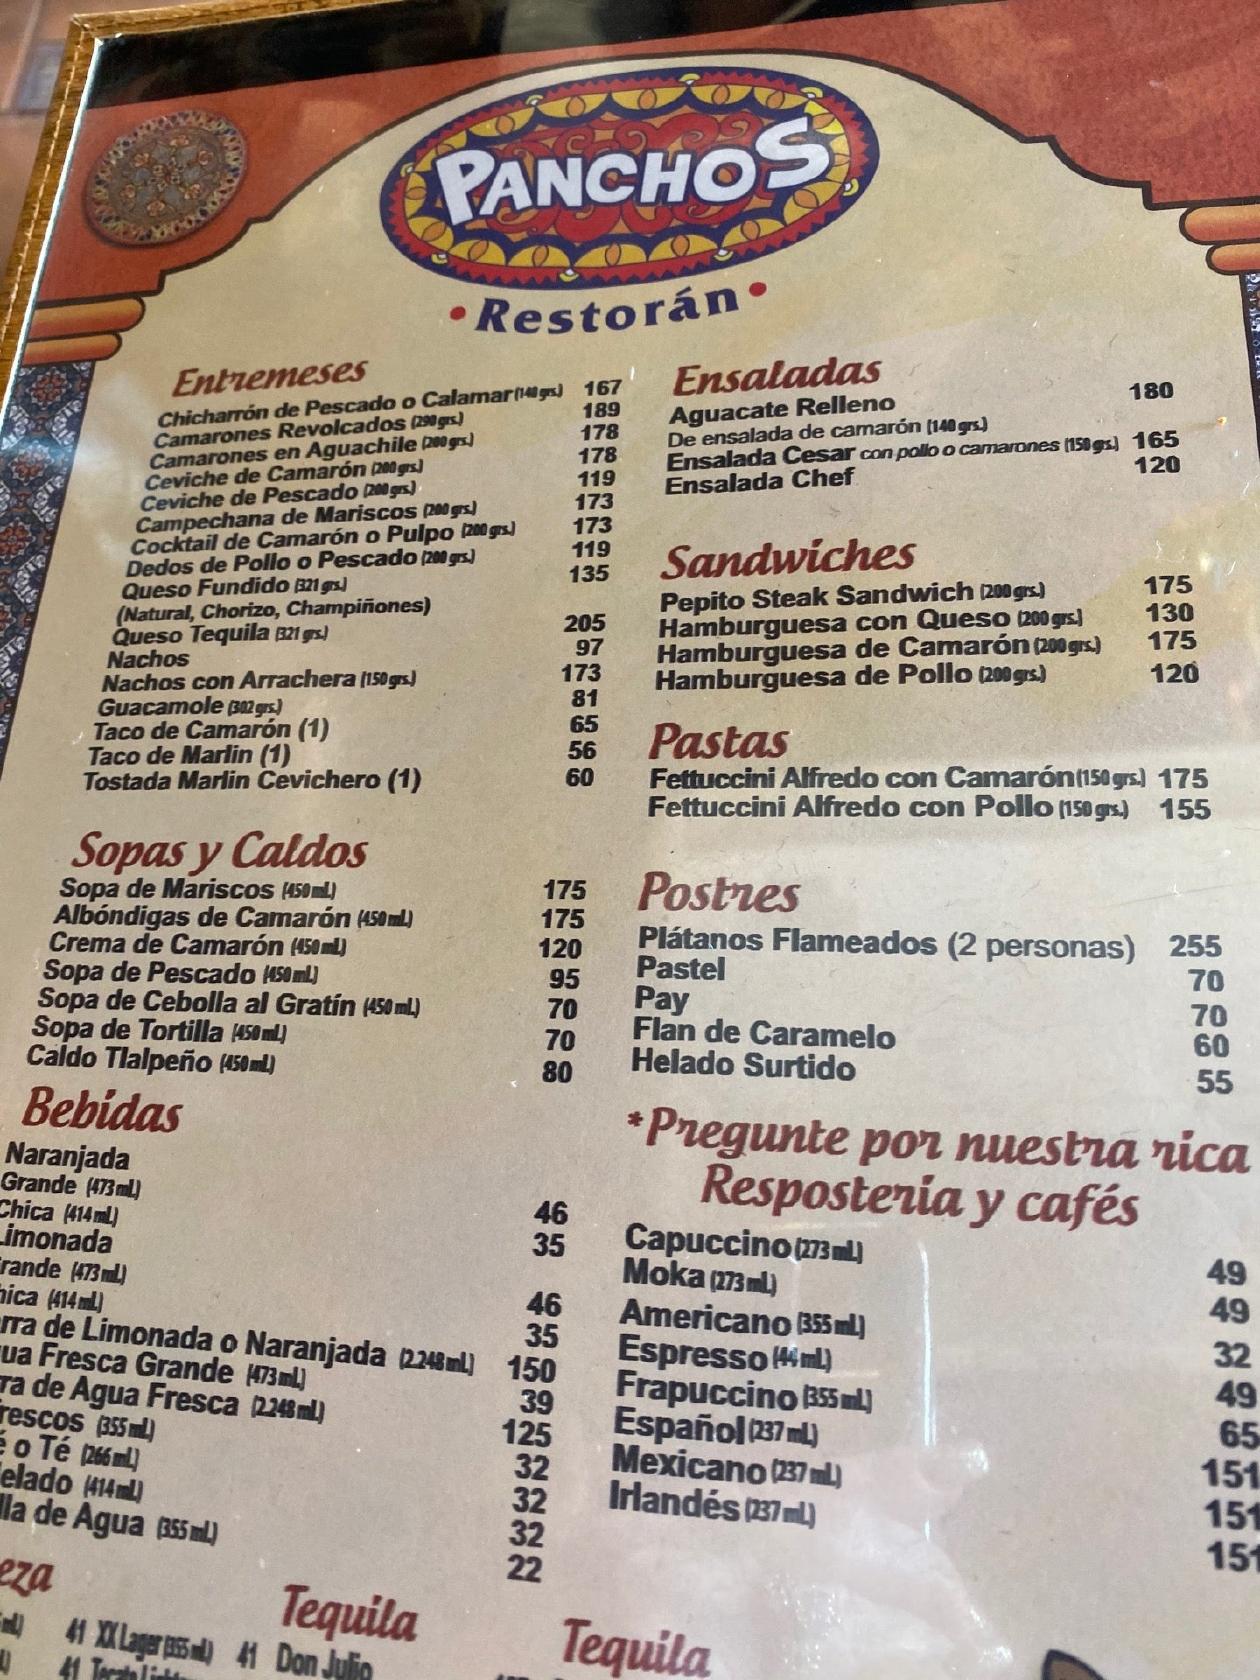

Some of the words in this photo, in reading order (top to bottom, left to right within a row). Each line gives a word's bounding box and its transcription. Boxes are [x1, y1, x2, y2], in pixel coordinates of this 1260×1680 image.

[437, 115, 832, 224] PANCHOS
[475, 286, 739, 334] Restorán
[172, 361, 368, 397] Entremeses
[585, 379, 622, 396] 167
[673, 357, 881, 396] Ensaladas
[1130, 382, 1173, 400] 180
[158, 404, 269, 428] Chicharrón
[274, 402, 299, 418] de
[305, 395, 396, 416] Pescado
[402, 397, 416, 409] o
[422, 389, 515, 408] Calamar
[583, 402, 620, 418] 189
[669, 402, 788, 428] Aguacate
[797, 395, 895, 416] Relleno
[154, 429, 270, 448] Camarones
[278, 416, 406, 438] Revolcados
[581, 423, 619, 441] 178
[668, 432, 696, 447] De
[702, 426, 793, 445] ensalada
[799, 424, 824, 439] de
[831, 418, 921, 438] camarón
[1133, 430, 1179, 449] 165
[579, 446, 617, 464] 178
[667, 448, 776, 472] Ensalada
[782, 445, 856, 464] Cesar
[860, 448, 893, 459] con
[896, 443, 939, 461] pollo
[942, 445, 956, 456] o
[959, 441, 1060, 455] camarones
[1135, 456, 1180, 473] 120
[578, 470, 615, 487] 119
[665, 472, 783, 495] Ensalada
[792, 467, 855, 488] Chef
[576, 493, 613, 510] 173
[136, 512, 274, 534] Campechana
[282, 508, 308, 524] de
[315, 505, 417, 522] Mariscos
[660, 538, 917, 580] Sandwiches
[570, 564, 609, 583] 135
[1144, 575, 1193, 594] 175
[122, 583, 191, 600] Queso
[198, 577, 289, 596] Fundido
[661, 591, 745, 616] Pepito
[753, 586, 828, 608] Steak
[837, 581, 974, 605] Sandwich
[117, 605, 194, 627] (Natural,
[201, 602, 280, 619] Chorizo,
[286, 597, 431, 618] Champiñones)
[564, 613, 606, 632] 205
[659, 617, 847, 640] Hamburguesa
[856, 615, 907, 631] con
[917, 608, 1011, 630] Queso
[1146, 603, 1194, 622] 130
[107, 649, 189, 668] Nachos
[576, 638, 604, 656] 97
[98, 696, 224, 717] Guacamole
[572, 689, 597, 707] 81
[568, 740, 596, 760] 56
[649, 723, 789, 760] Pastas
[89, 746, 140, 765] Taco
[146, 746, 175, 764] de
[181, 744, 253, 764] Marlin
[260, 744, 290, 768] (1)
[84, 771, 171, 791] Tostada
[178, 770, 250, 790] Marlin
[258, 769, 381, 789] Cevichero
[388, 768, 421, 794] (1)
[566, 768, 594, 787] 60
[650, 767, 775, 789] Fettuccini
[781, 766, 878, 788] Alfredo
[886, 772, 936, 788] con
[945, 765, 1074, 787] Camarón
[1159, 768, 1208, 788] 175
[71, 831, 187, 875] Sopas
[188, 842, 223, 877] y
[232, 831, 368, 868] Caldos
[59, 877, 119, 902] Sopa
[127, 878, 156, 898] de
[162, 878, 274, 899] Mariscos
[544, 879, 586, 900] 175
[638, 871, 800, 912] Postres
[53, 904, 190, 931] Albóndigas
[198, 906, 227, 927] de
[236, 906, 351, 928] Camarón
[639, 926, 763, 950] Plátanos
[774, 928, 937, 955] Flameados
[949, 932, 976, 961] (2
[987, 935, 1134, 964] personas)
[1171, 935, 1221, 956] 255
[550, 968, 580, 989] 95
[637, 955, 725, 980] Pastel
[1189, 970, 1223, 991] 70
[38, 987, 99, 1013] Sopa
[106, 989, 136, 1010] de
[144, 990, 237, 1013] Cebolla
[245, 991, 269, 1014] al
[276, 993, 356, 1016] Gratín
[635, 985, 689, 1016] Pay
[634, 1016, 695, 1041] Flan
[705, 1019, 740, 1043] de
[750, 1020, 895, 1049] Caramelo
[1195, 1034, 1229, 1057] 60
[27, 1044, 97, 1067] Caldo
[106, 1046, 212, 1075] Tlalpeño
[542, 1060, 573, 1083] 80
[22, 1086, 183, 1133] Bebidas
[5, 1141, 130, 1173] Naranjada
[859, 1129, 942, 1166] por
[956, 1131, 1139, 1169] nuestra
[1153, 1130, 1249, 1173] rica
[0, 1171, 77, 1194] Grande
[534, 1200, 568, 1225] 46
[970, 1190, 1004, 1228] y
[1017, 1184, 1138, 1231] cafés
[532, 1232, 565, 1257] 35
[626, 1222, 792, 1258] Capuccino
[623, 1257, 705, 1288] Moka
[1207, 1259, 1246, 1285] 49
[619, 1298, 792, 1336] Americano
[43, 1314, 75, 1339] de
[82, 1316, 213, 1351] Limonada
[220, 1334, 238, 1353] o
[245, 1330, 386, 1369] Naranjada
[619, 1333, 768, 1371] Espresso
[1214, 1341, 1251, 1368] 32
[508, 1355, 556, 1383] 150
[502, 1418, 551, 1447] 125
[614, 1406, 745, 1445] Español
[1220, 1420, 1260, 1450] 65
[612, 1443, 766, 1484] Mexicano
[610, 1480, 740, 1521] Irlandés
[34, 1498, 67, 1526] de
[72, 1502, 144, 1539] Agua
[507, 1554, 542, 1583] 22
[282, 1584, 418, 1642] Tequila
[66, 1618, 86, 1644] 41
[237, 1641, 257, 1669] 41
[276, 1642, 318, 1676] Don
[563, 1618, 709, 1678] Tequila
